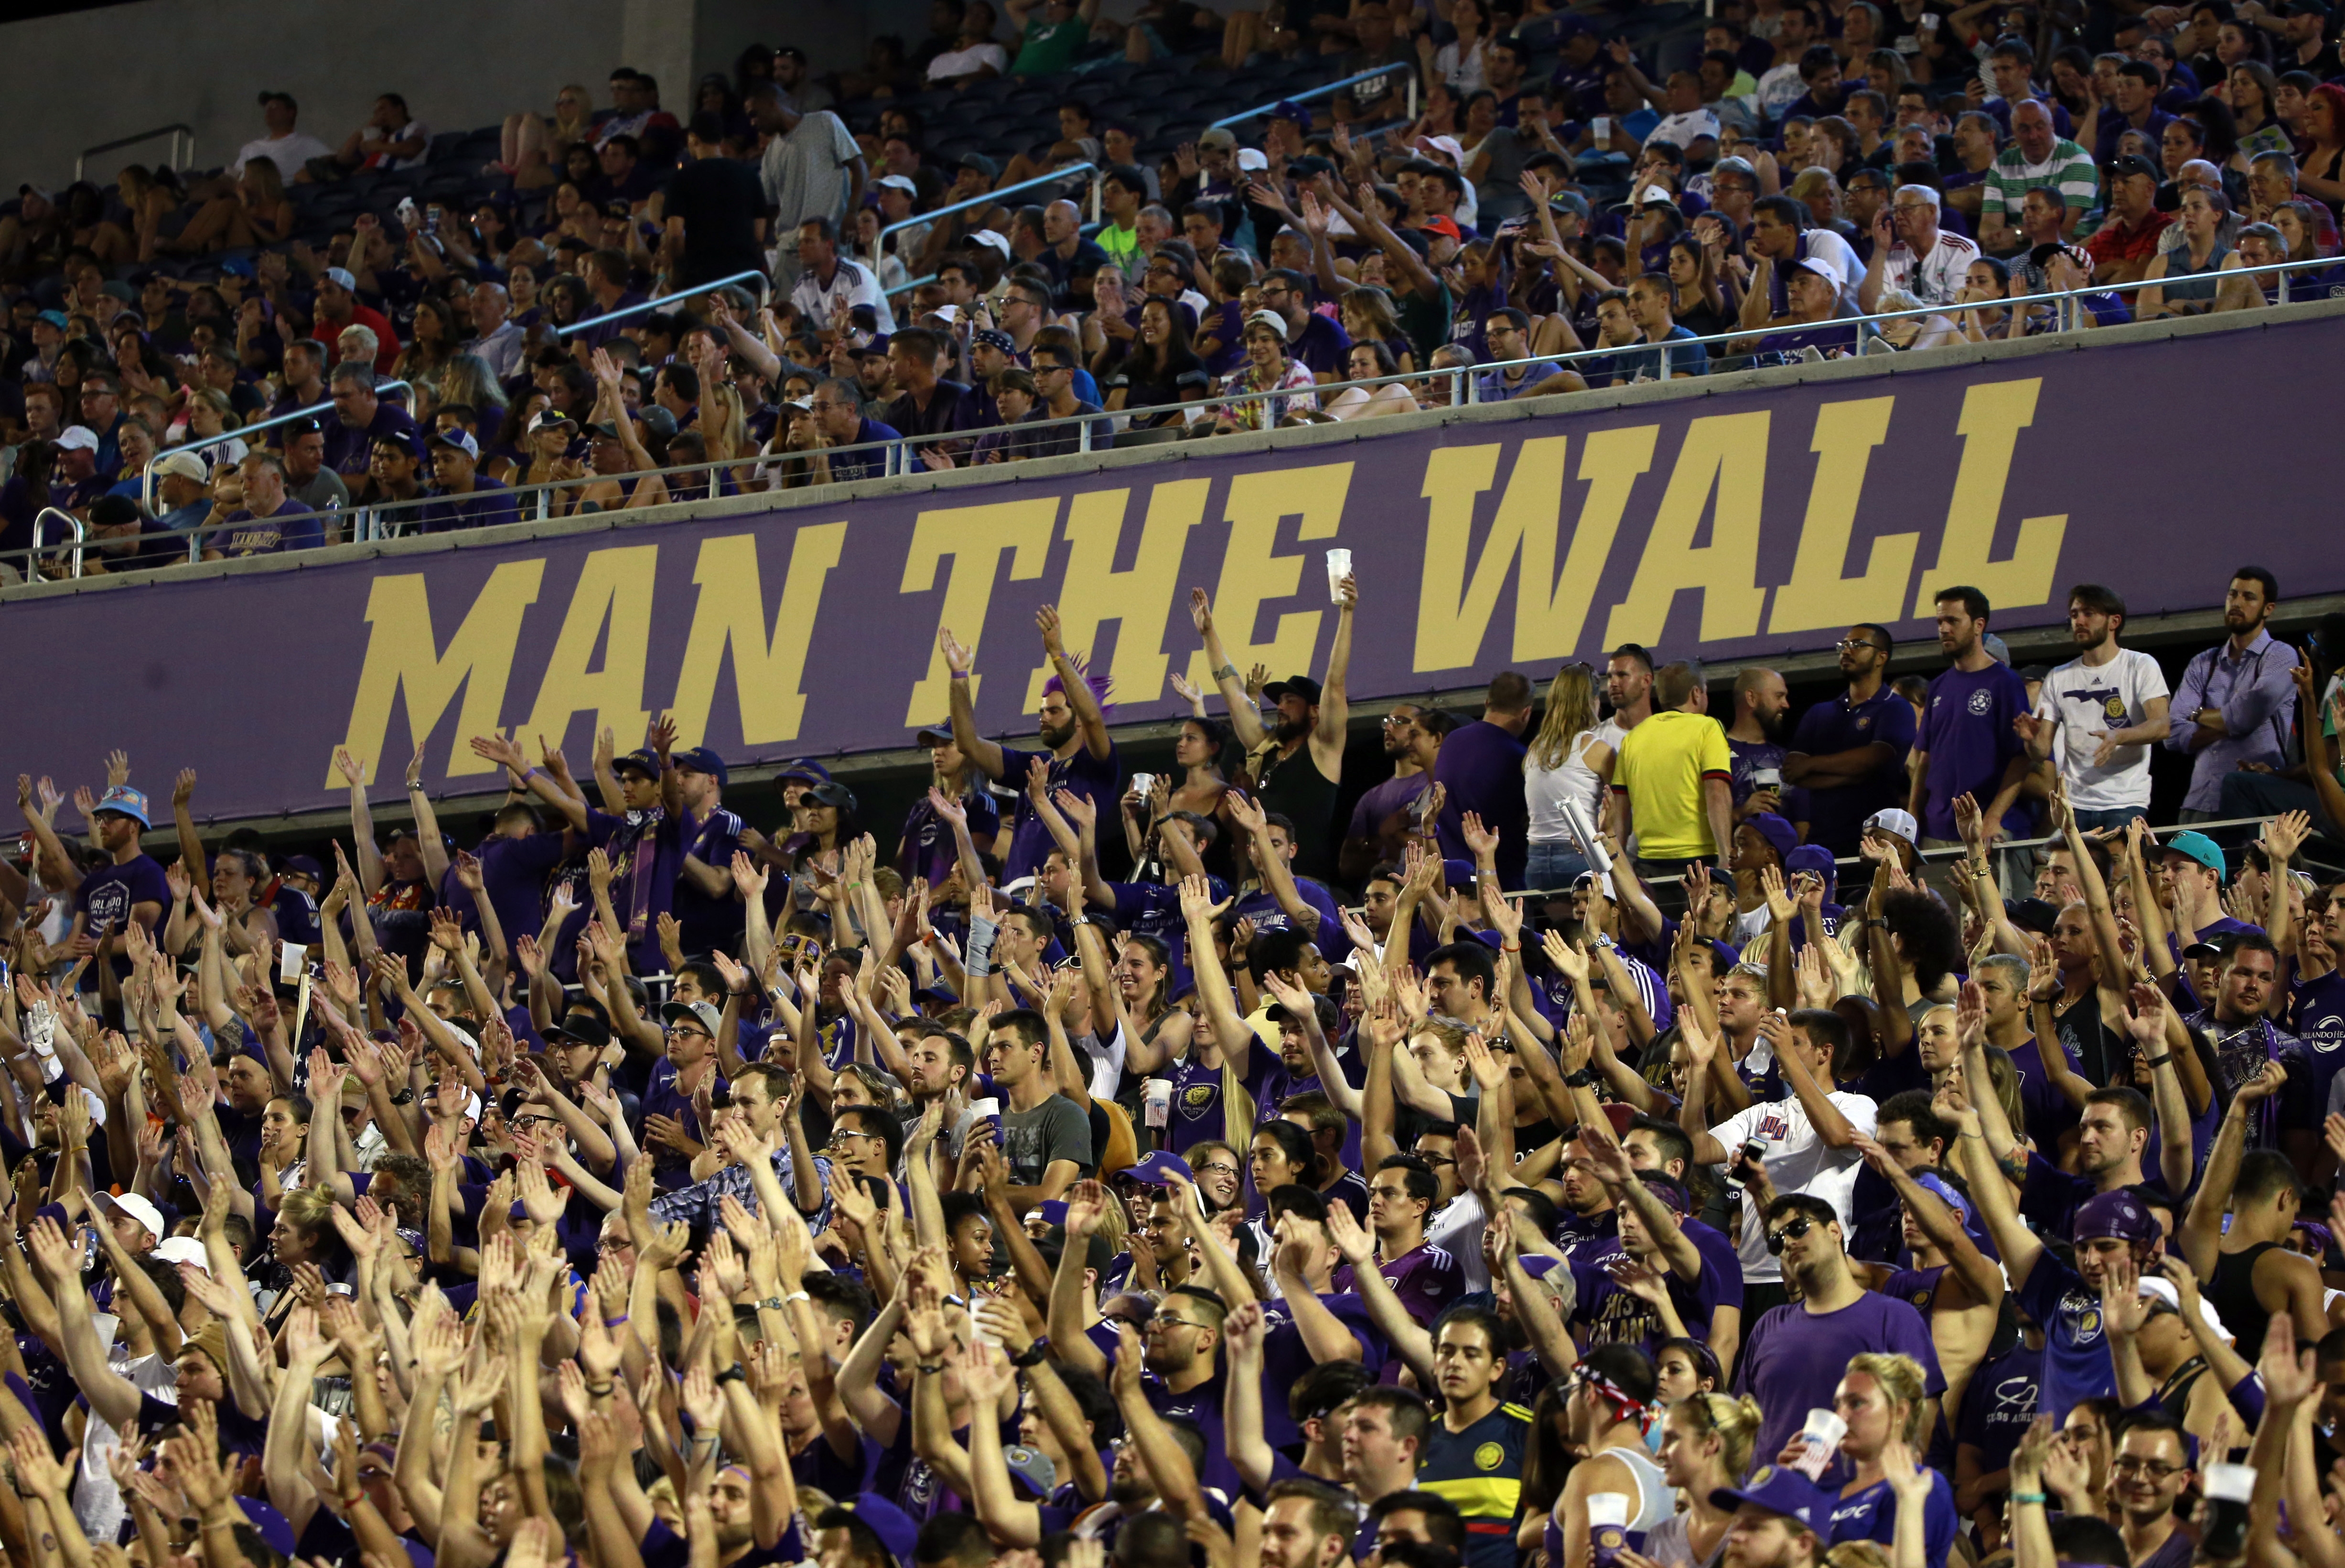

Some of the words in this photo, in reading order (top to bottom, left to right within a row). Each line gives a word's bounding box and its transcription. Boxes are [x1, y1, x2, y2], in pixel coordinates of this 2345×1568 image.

[325, 522, 847, 790] MAN
[901, 462, 1354, 728] THE
[1414, 378, 2066, 672] WALL
[2300, 1031, 2333, 1040] ORLANDO
